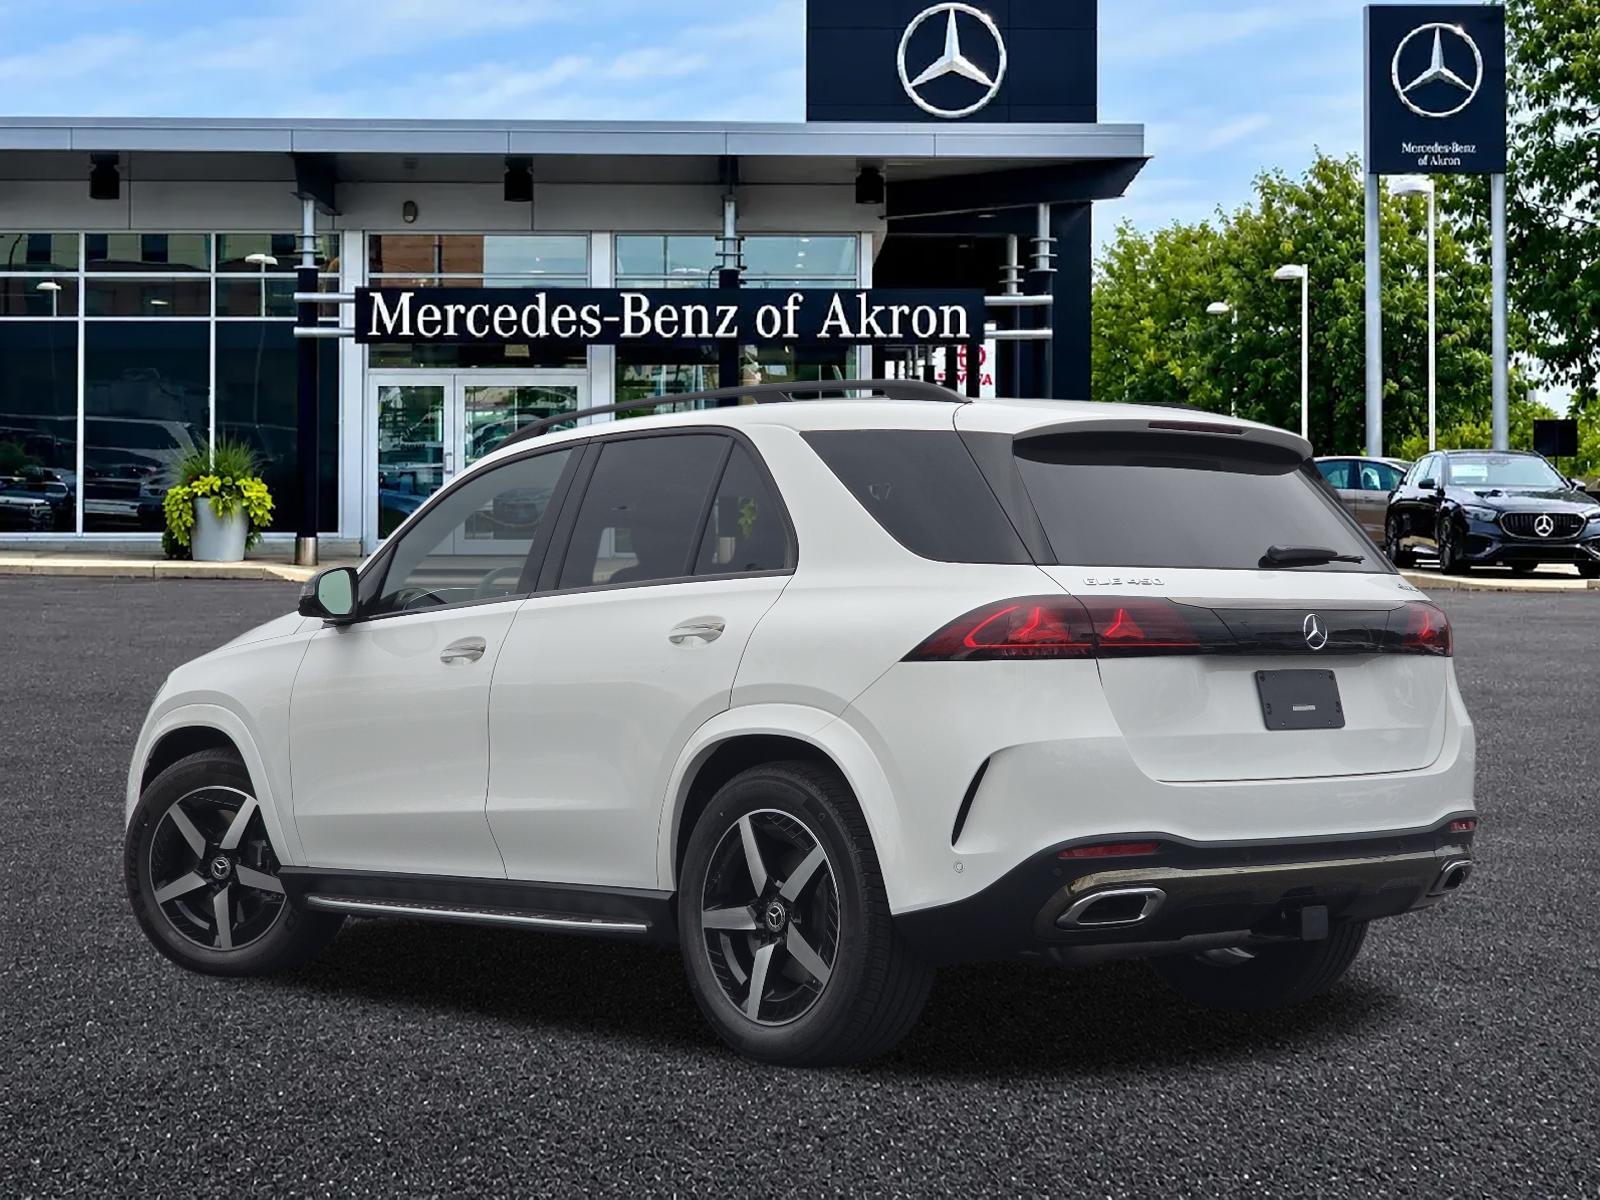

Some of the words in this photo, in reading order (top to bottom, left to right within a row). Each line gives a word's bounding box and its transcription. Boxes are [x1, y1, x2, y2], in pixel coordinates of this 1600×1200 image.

[1401, 141, 1477, 154] Mercedes-Benz
[1417, 154, 1429, 166] of
[1430, 154, 1461, 166] Akron
[367, 292, 738, 339] Mercedes-Benz
[755, 292, 804, 339] of
[816, 292, 970, 339] Akron
[1082, 575, 1123, 586] GLE
[1127, 577, 1166, 586] 450
